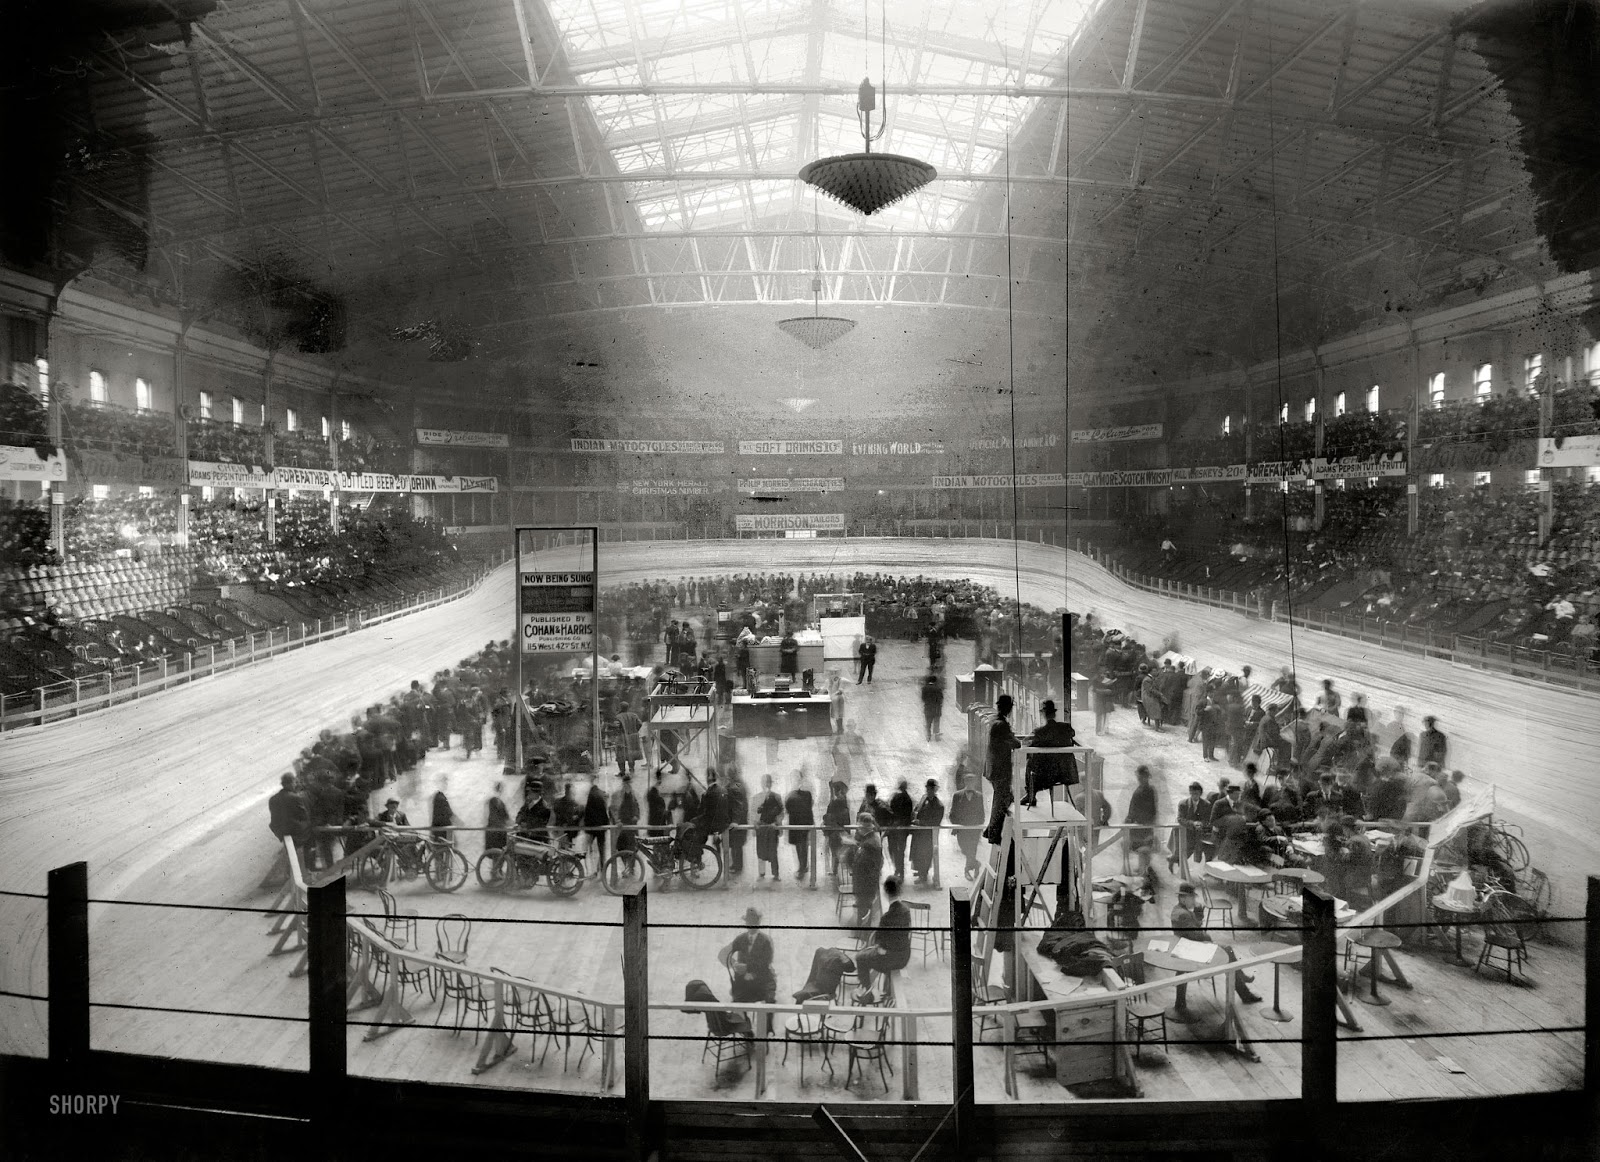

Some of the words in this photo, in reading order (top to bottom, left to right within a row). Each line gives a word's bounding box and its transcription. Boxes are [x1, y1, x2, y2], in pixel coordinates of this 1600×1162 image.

[573, 440, 605, 450] INDIAN
[755, 442, 781, 453] SOFT
[785, 442, 823, 453] DRINKS
[889, 442, 921, 455] WORLD
[375, 473, 395, 490] BEER
[411, 476, 437, 491] DRINK
[460, 477, 496, 491] CLYSMIC
[933, 476, 968, 487] INDIAN
[1118, 471, 1146, 486] SCOTCH
[754, 515, 809, 529] MORRISON
[524, 574, 544, 584] NOW
[545, 574, 569, 583] BEING
[570, 573, 592, 583] SUNG
[527, 643, 537, 651] 115
